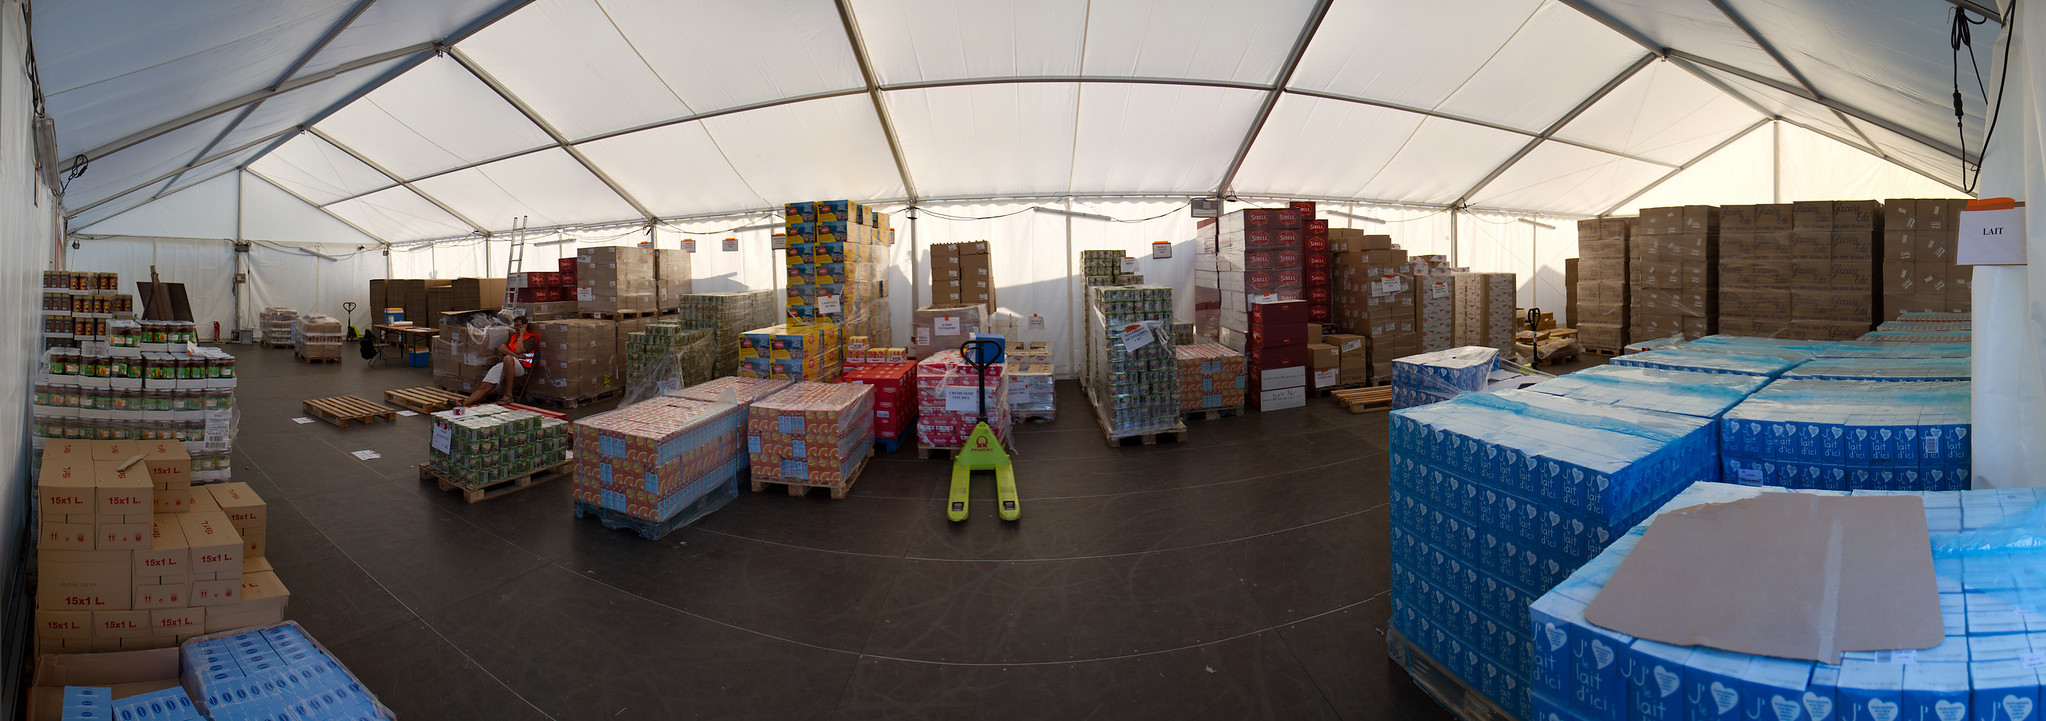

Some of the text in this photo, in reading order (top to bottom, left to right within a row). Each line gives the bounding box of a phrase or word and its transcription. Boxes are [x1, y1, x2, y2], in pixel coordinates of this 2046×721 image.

[1983, 227, 2004, 236] LAIT
[1800, 438, 1814, 447] lait
[1823, 440, 1838, 449] lait
[1848, 441, 1862, 451] lait
[1872, 442, 1886, 451] lait
[1896, 442, 1911, 451] lait
[1801, 447, 1817, 456] d'ici
[1824, 449, 1840, 457] d'ici
[1848, 451, 1865, 459] d'ici
[1872, 451, 1889, 459] d'ici
[1897, 451, 1914, 459] d'ici
[153, 467, 171, 475] 15x1
[108, 496, 141, 504] 15x1 L.
[145, 558, 166, 567] 15x1
[201, 554, 221, 563] 15x1
[65, 596, 105, 605] 15x1 L.
[47, 621, 80, 629] 15x1 L.
[105, 620, 137, 628] 15x1 L.
[161, 617, 193, 626] 15x1 L.
[1576, 661, 1603, 690] lait
[1577, 685, 1607, 711] d'ici
